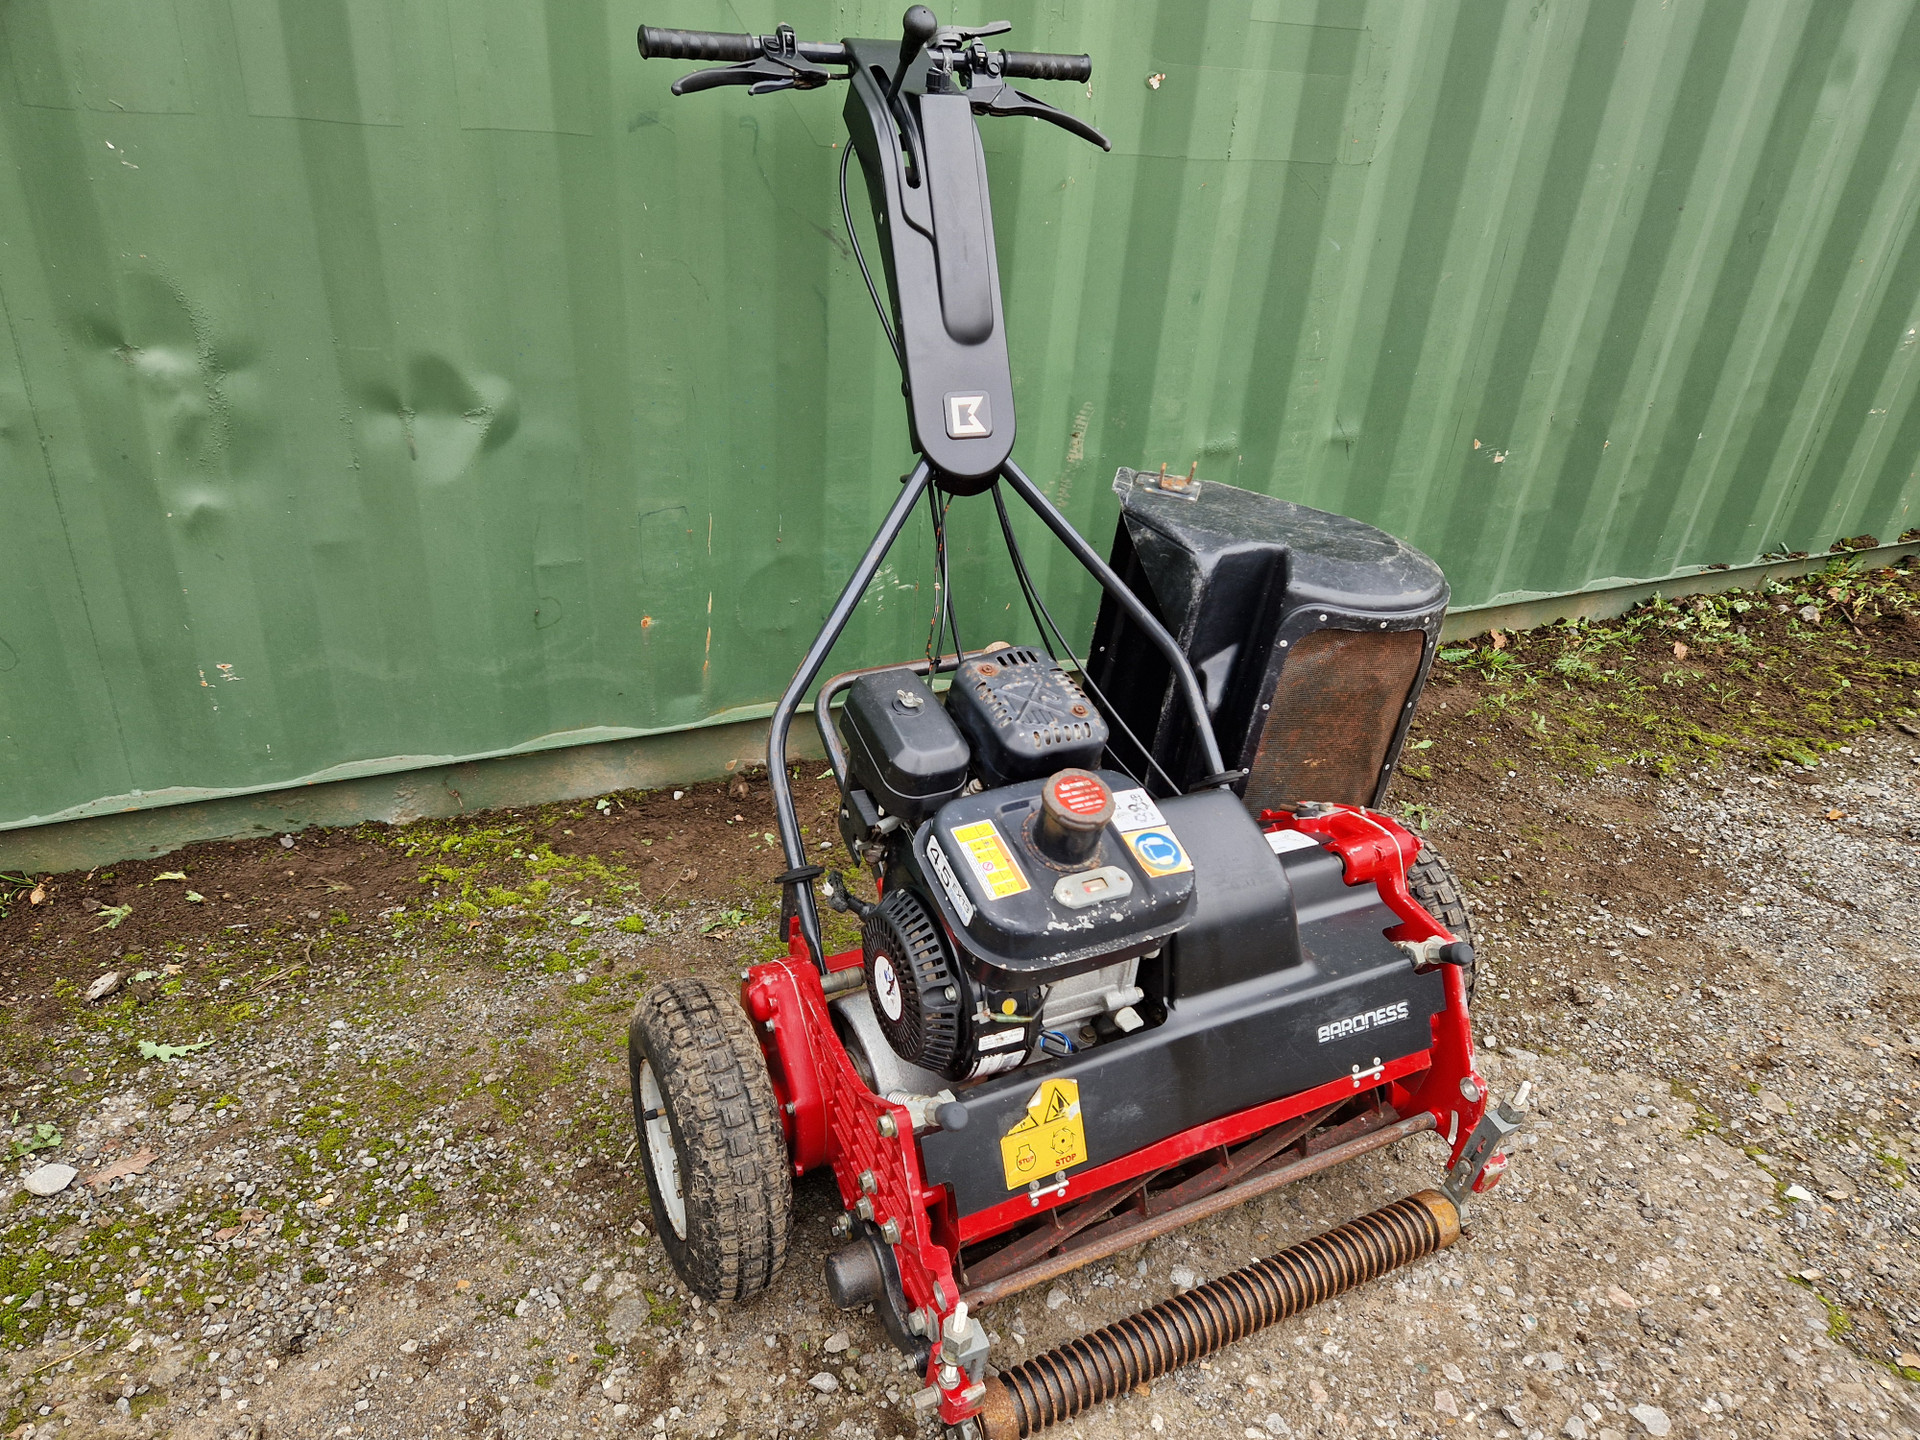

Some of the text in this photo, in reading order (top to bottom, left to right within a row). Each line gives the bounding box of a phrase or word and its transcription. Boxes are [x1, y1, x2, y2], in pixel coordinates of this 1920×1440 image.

[930, 847, 952, 888] 4.5
[1317, 1001, 1410, 1043] BARONESS
[1018, 1155, 1034, 1166] STOP
[1055, 1153, 1077, 1167] STOP
